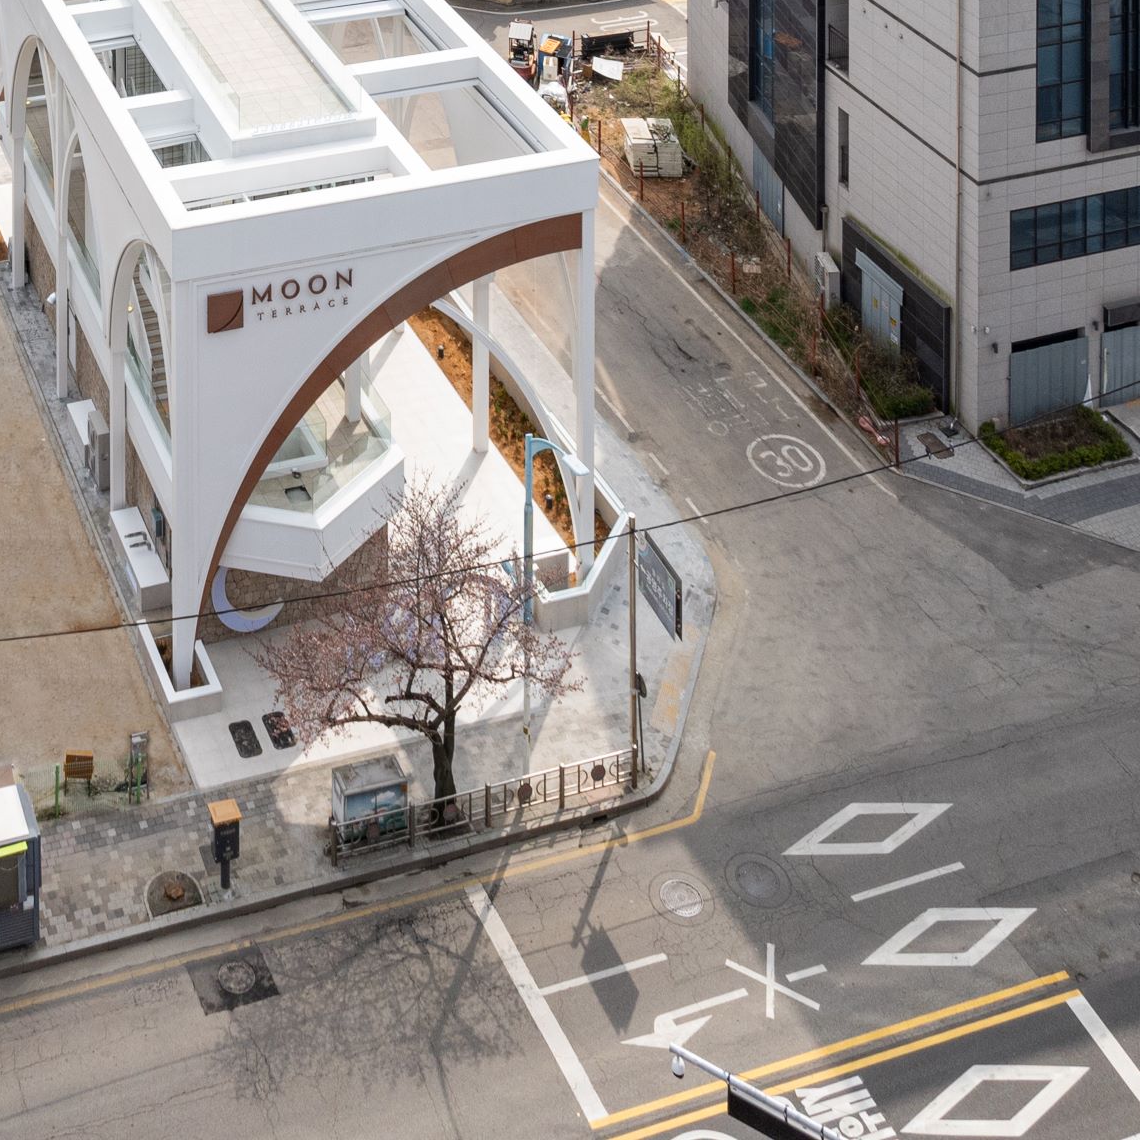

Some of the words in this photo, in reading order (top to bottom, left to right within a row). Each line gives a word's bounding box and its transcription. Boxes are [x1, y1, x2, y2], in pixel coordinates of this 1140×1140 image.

[251, 268, 353, 305] MOON
[257, 296, 349, 321] TERRACE
[759, 444, 814, 478] 30
